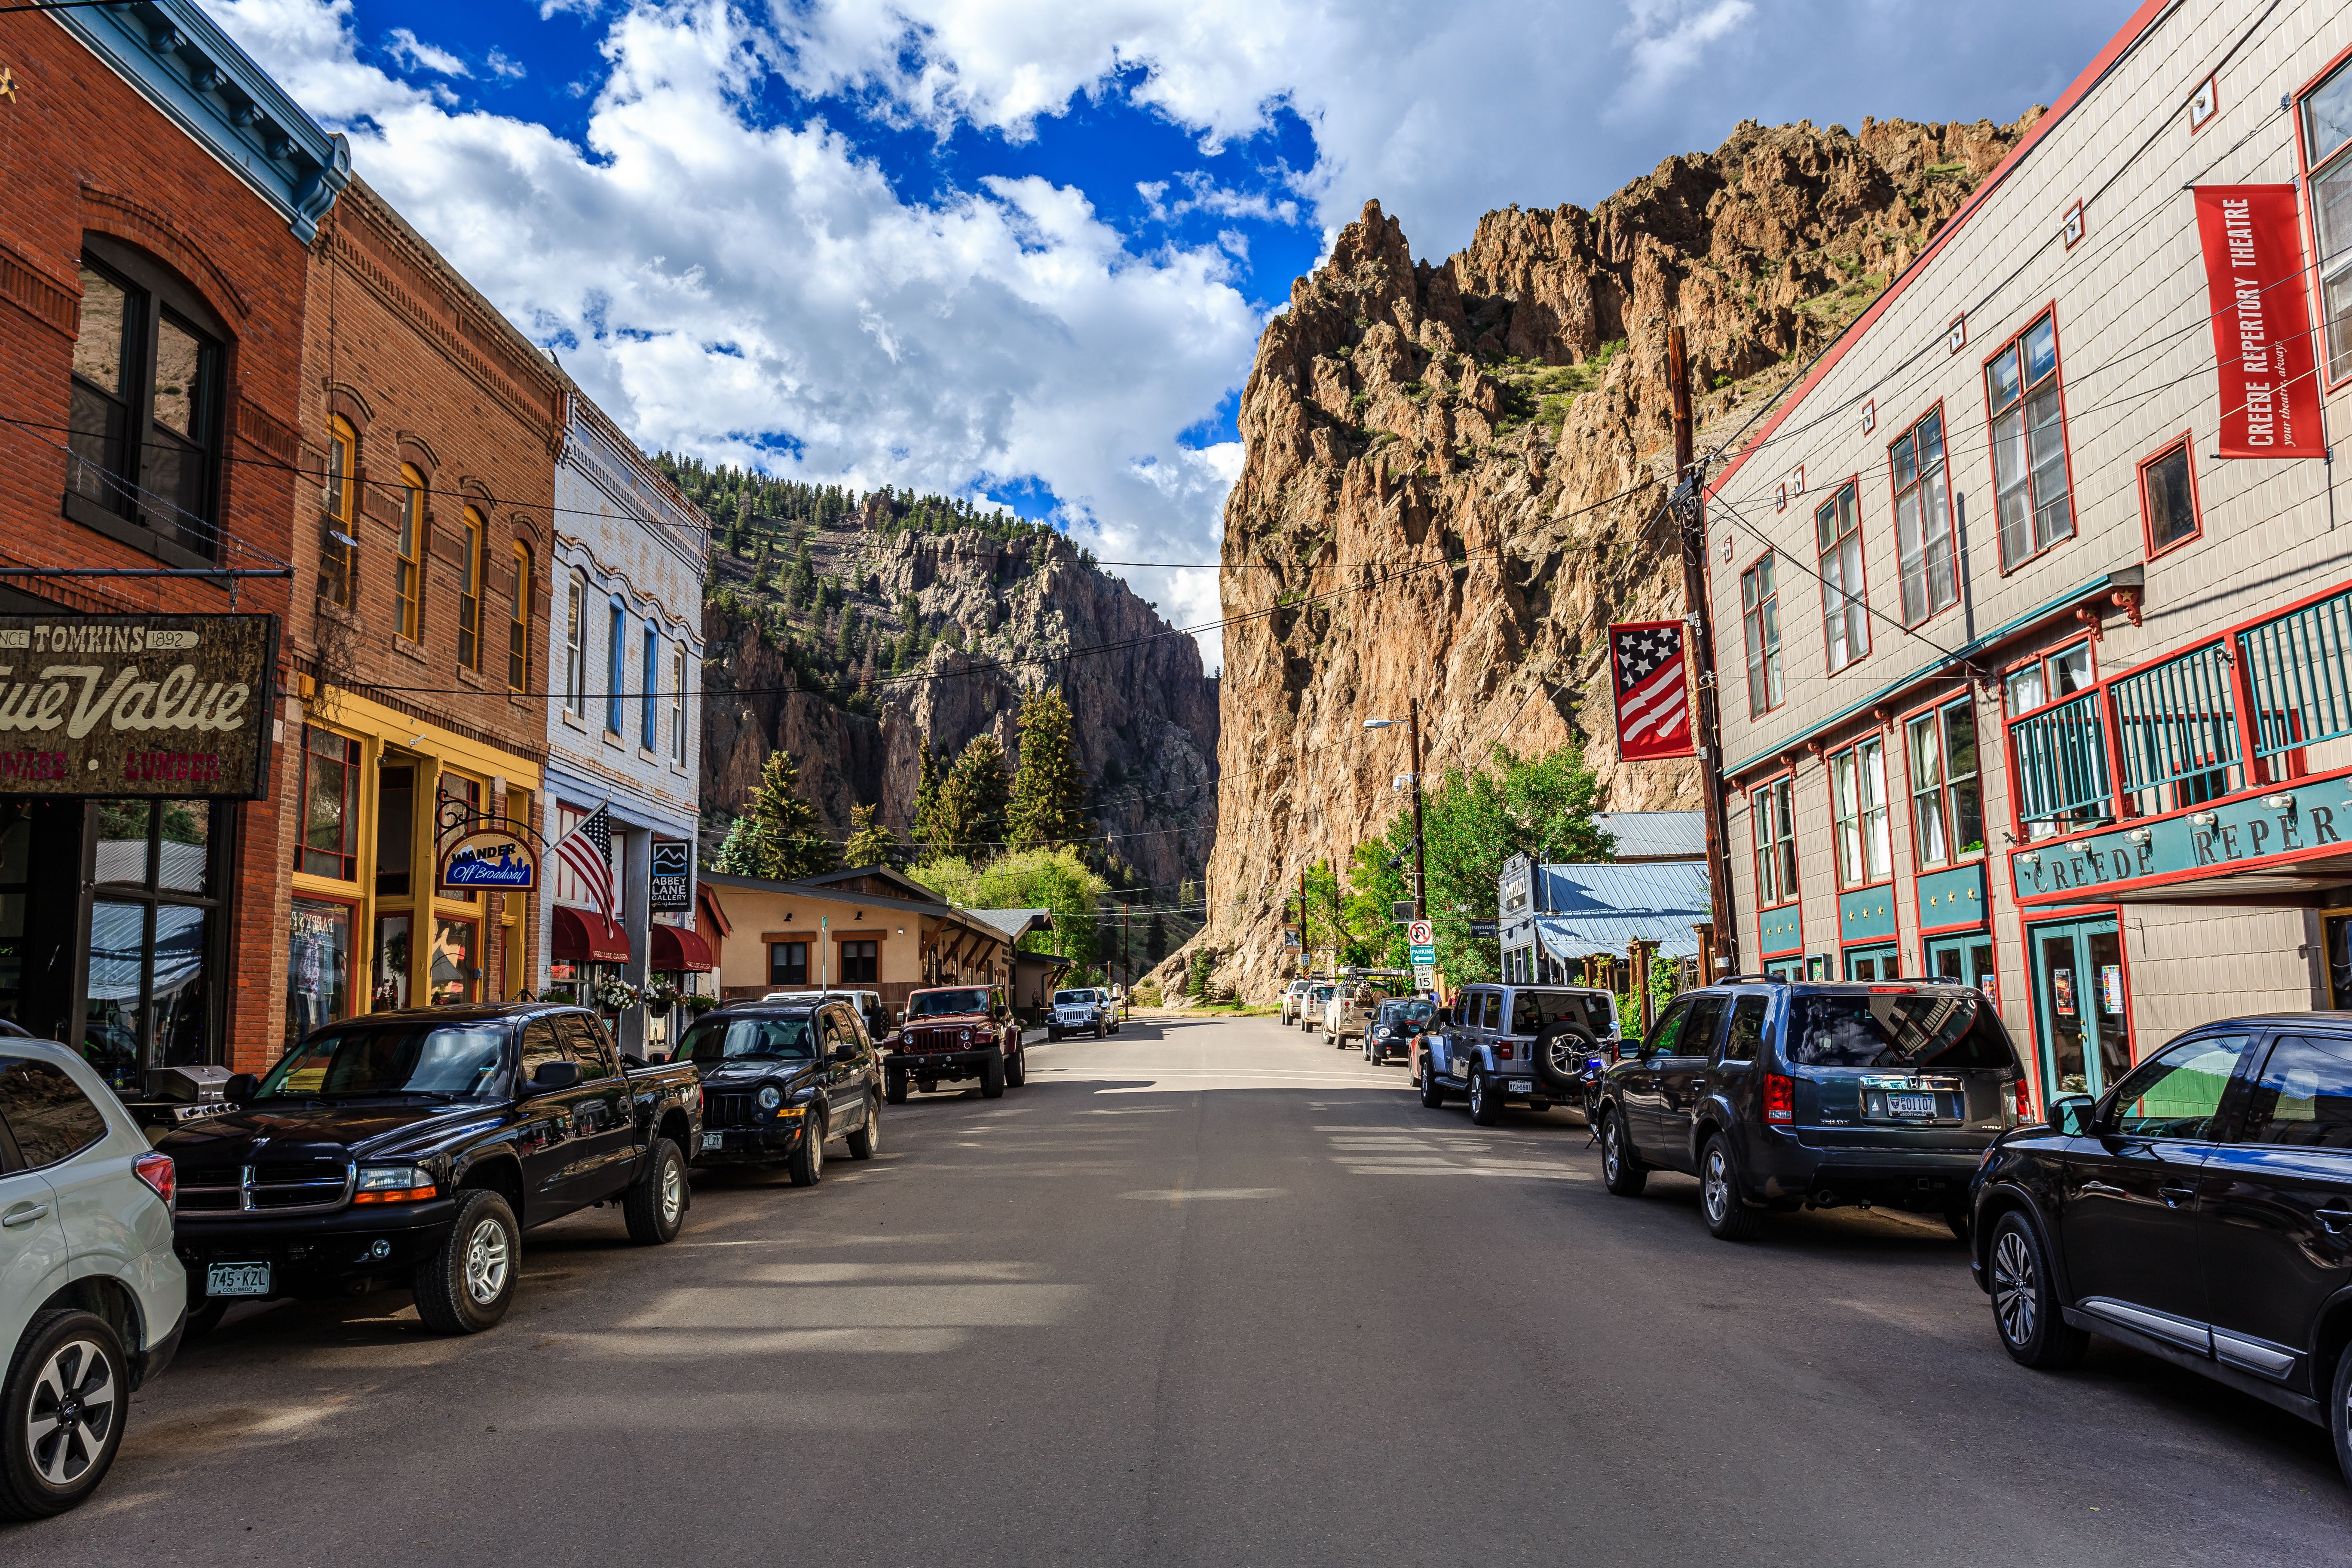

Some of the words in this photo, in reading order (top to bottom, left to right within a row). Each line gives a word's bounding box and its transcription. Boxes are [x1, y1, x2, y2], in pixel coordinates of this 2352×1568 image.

[2222, 198, 2256, 268] THEATRE
[2234, 277, 2269, 373] REPERTORY
[2245, 381, 2274, 447] CREEDE
[2284, 421, 2296, 447] your
[34, 625, 145, 653] TOMKINS
[152, 632, 184, 646] 1892
[0, 665, 69, 731] ue
[39, 664, 249, 739] Value
[0, 751, 66, 779] WARE
[126, 752, 220, 781] LUMBER
[452, 843, 517, 864] WANDER
[453, 864, 480, 882] Off
[475, 865, 525, 883] Broadway
[652, 877, 686, 885] ABBEY
[2034, 844, 2155, 893] CREEDE
[652, 885, 686, 894] LANE
[1419, 977, 1430, 986] 15
